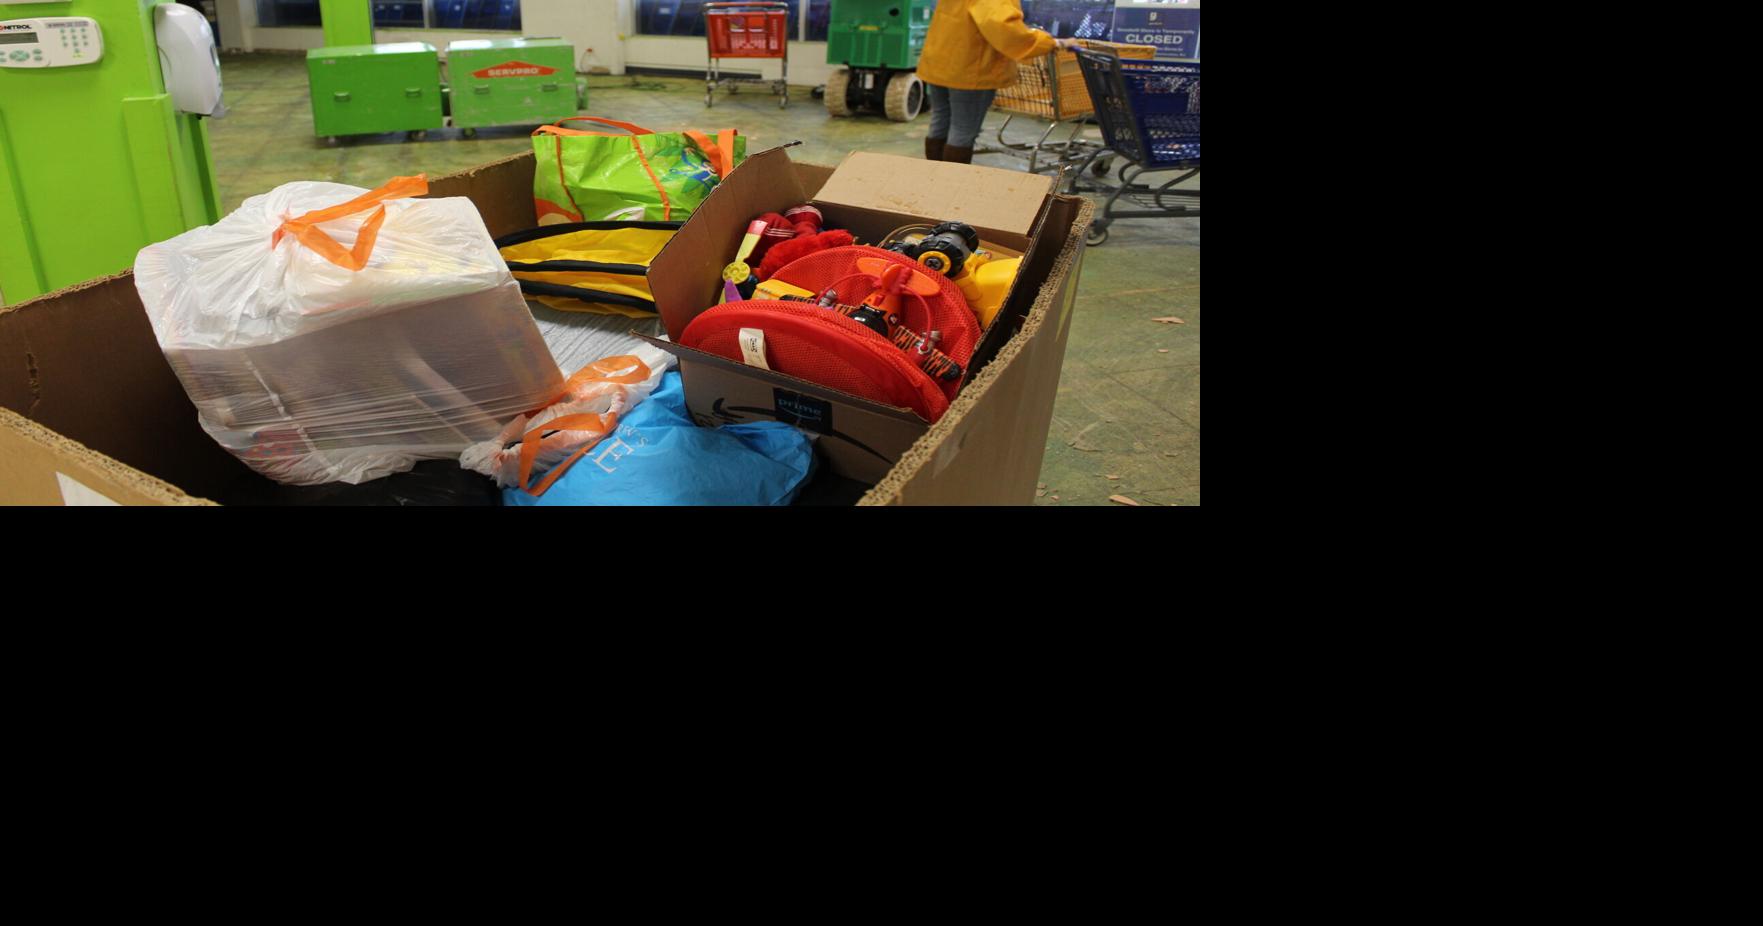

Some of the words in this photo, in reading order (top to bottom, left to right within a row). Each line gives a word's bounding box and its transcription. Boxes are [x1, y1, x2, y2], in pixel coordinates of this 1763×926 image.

[1125, 33, 1183, 44] CLOSED
[487, 67, 539, 77] SERVPRO
[778, 398, 822, 415] prime
[585, 437, 634, 473] E
